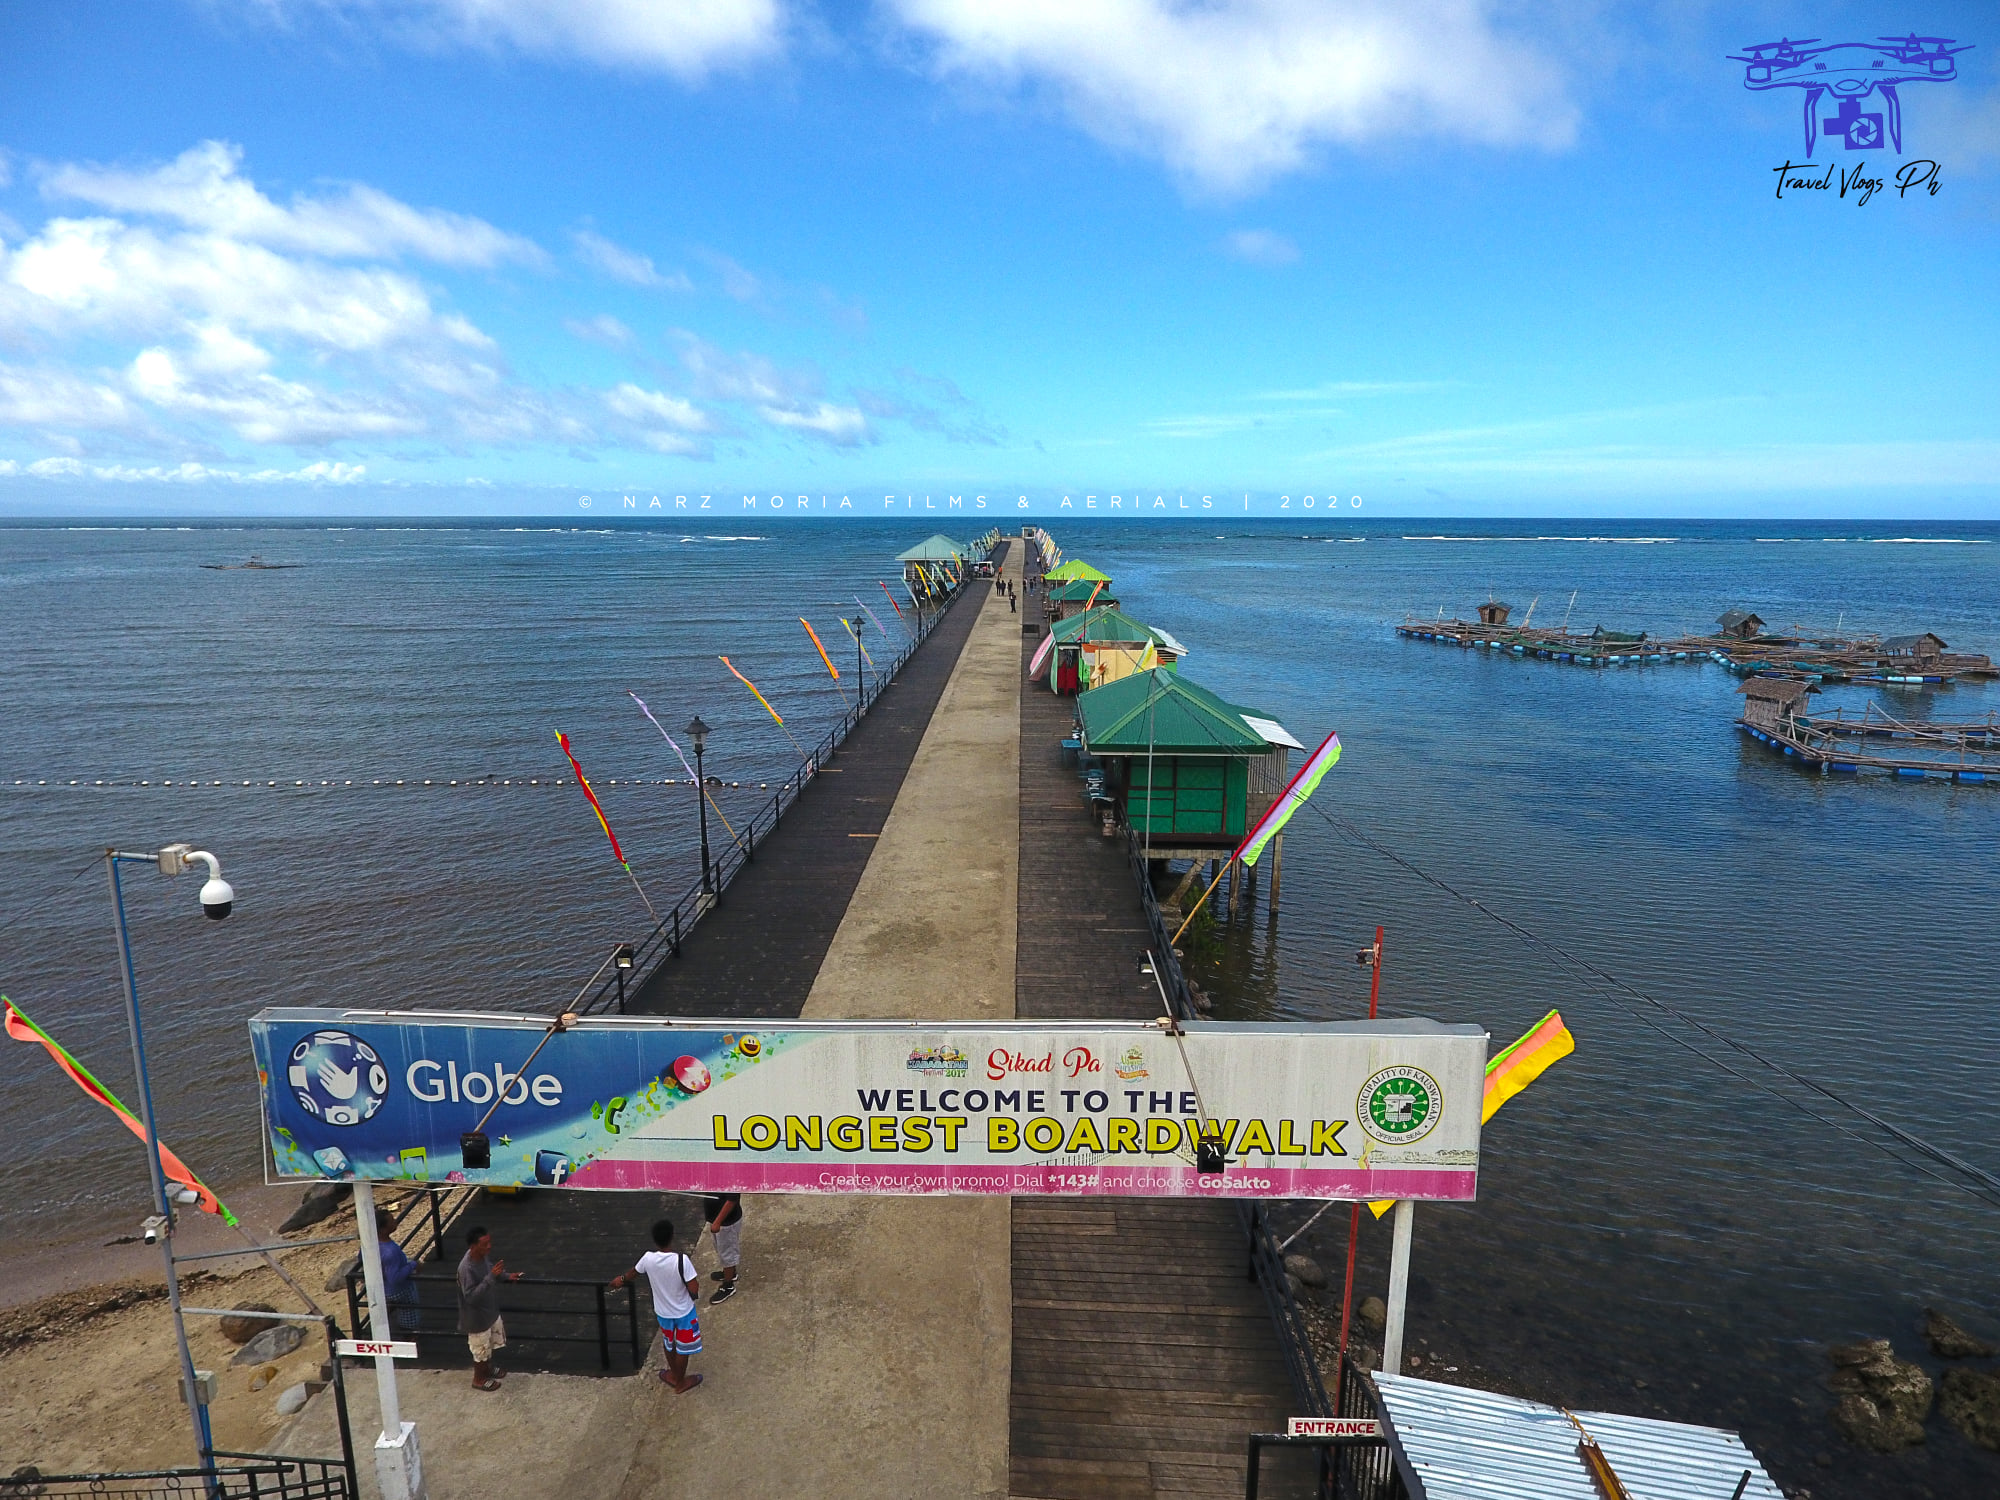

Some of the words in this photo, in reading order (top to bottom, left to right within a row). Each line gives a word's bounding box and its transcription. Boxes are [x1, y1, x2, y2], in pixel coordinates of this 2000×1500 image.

[945, 1068, 967, 1078] 2017
[987, 1048, 1055, 1081] Sikad
[1063, 1046, 1104, 1078] Pa
[406, 1059, 563, 1106] Globe
[857, 1089, 1045, 1113] WELCOME
[1061, 1090, 1109, 1114] TO
[1124, 1090, 1198, 1114] THE
[1360, 1068, 1397, 1123] MUNICIPALITY
[1399, 1068, 1413, 1076] OF
[1413, 1071, 1439, 1122] KAUSWAGAN
[712, 1114, 967, 1153] LONGEST
[987, 1116, 1349, 1157] BOARDWALK
[1376, 1131, 1405, 1142] OFFICIAL
[1406, 1130, 1424, 1140] SEAL
[819, 1172, 870, 1187] Create
[874, 1175, 911, 1191] your
[913, 1175, 948, 1187] own
[952, 1173, 1009, 1191] promo!
[1014, 1174, 1042, 1187] Dial
[1103, 1174, 1134, 1189] and
[1137, 1174, 1195, 1189] choose
[1198, 1176, 1271, 1190] GoSakto
[356, 1343, 393, 1354] EXIT
[1295, 1422, 1376, 1434] ENTRANCE
